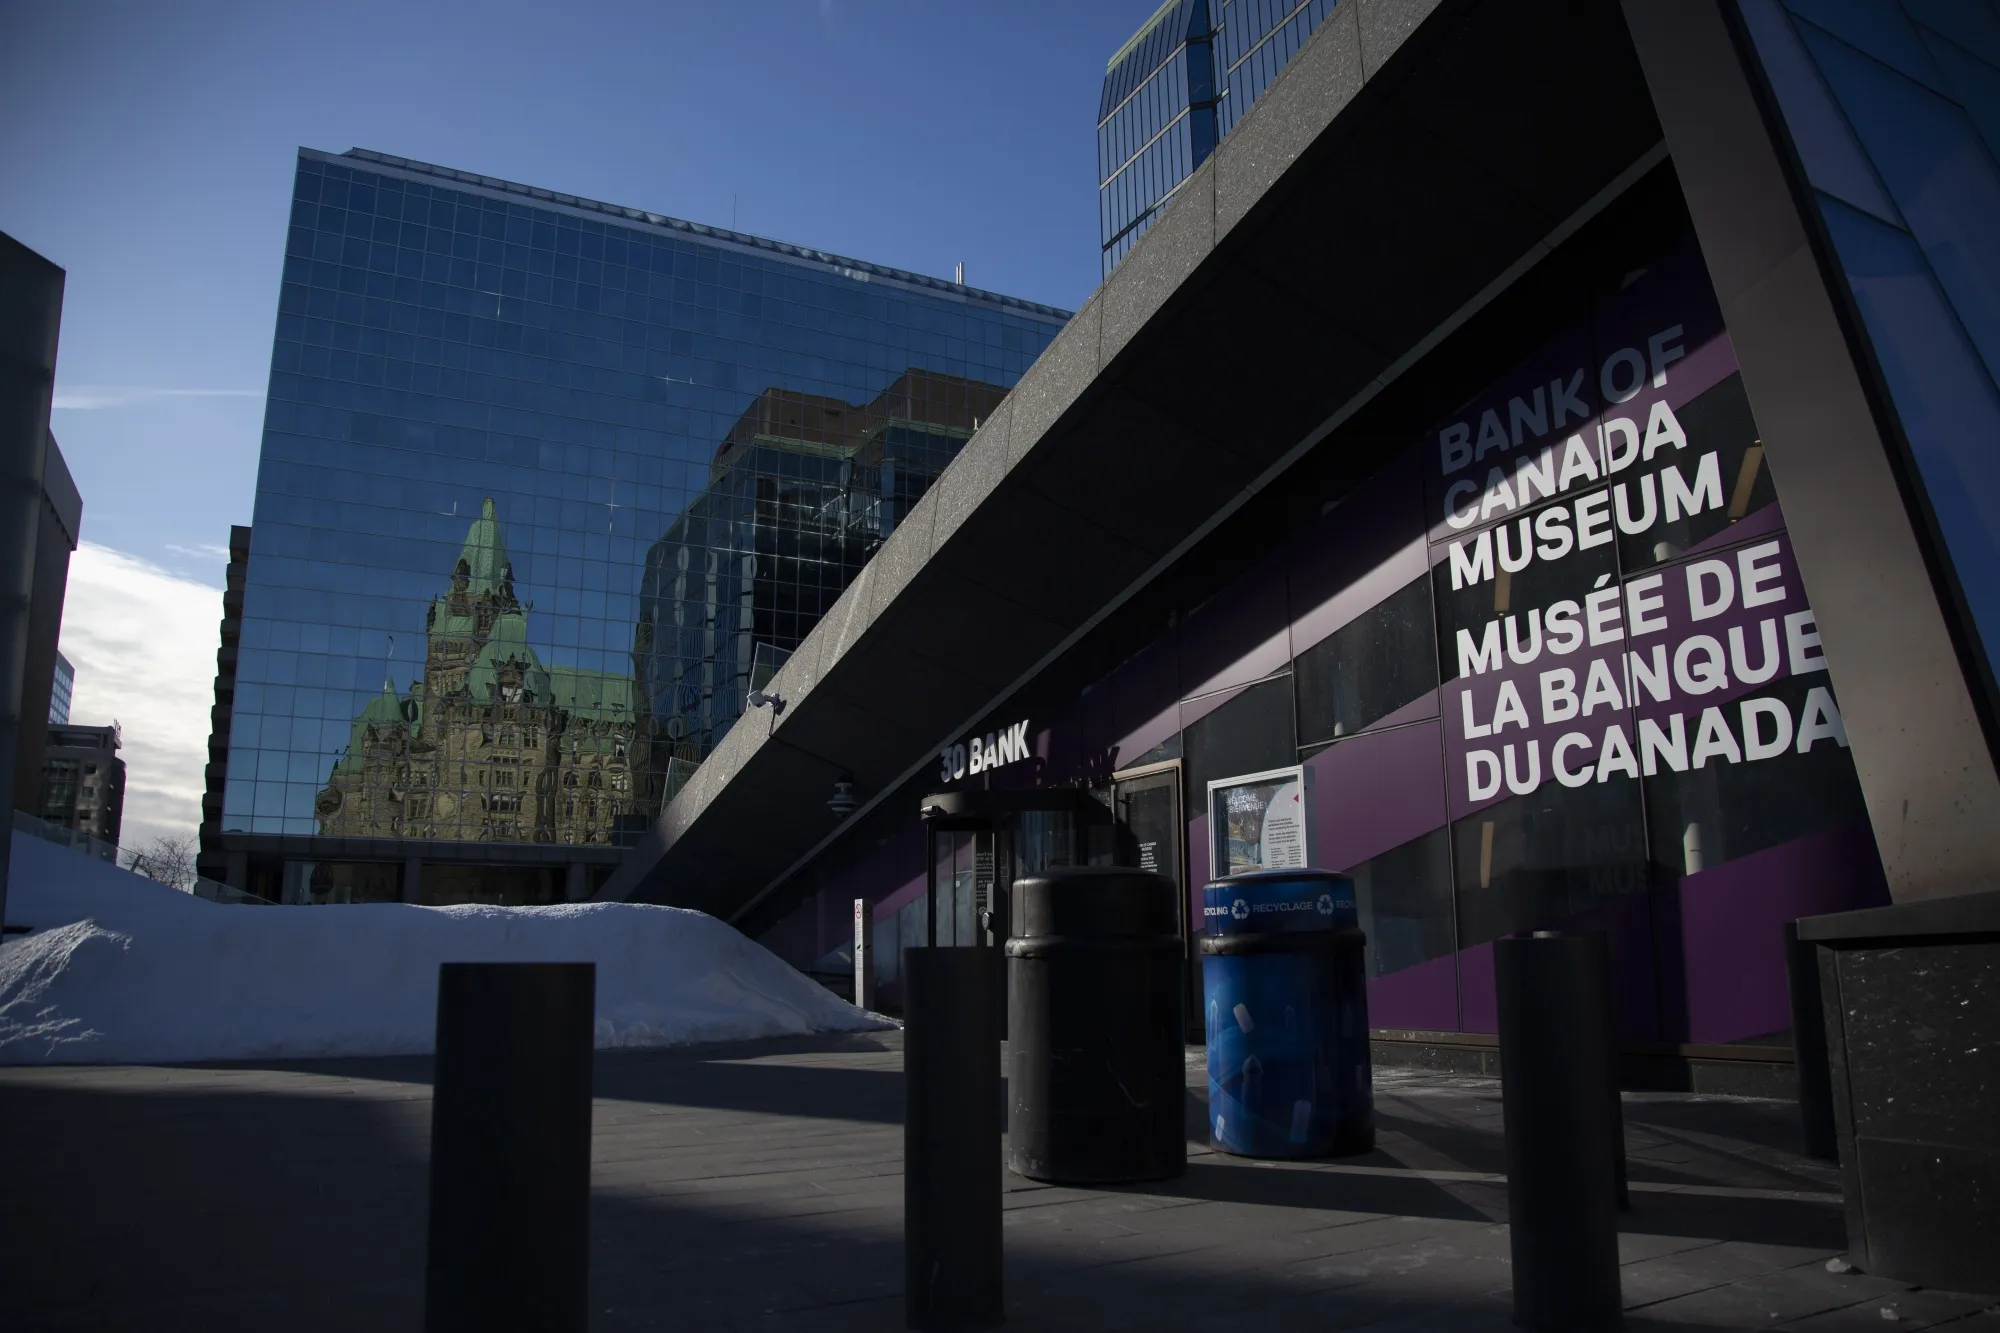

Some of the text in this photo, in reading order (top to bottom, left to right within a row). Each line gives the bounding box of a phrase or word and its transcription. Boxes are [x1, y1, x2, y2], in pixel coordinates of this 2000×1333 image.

[1439, 323, 1685, 476] BANK OF
[1443, 399, 1688, 529] CANADA
[1448, 450, 1724, 591] MUSEUM
[1456, 540, 1787, 678] MUSÉE DE
[1460, 609, 1829, 740] LA BANQUE
[940, 718, 1031, 783] 30 BANK
[1465, 686, 1849, 802] DU CANADA
[1252, 901, 1313, 913] RECYCLAGE
